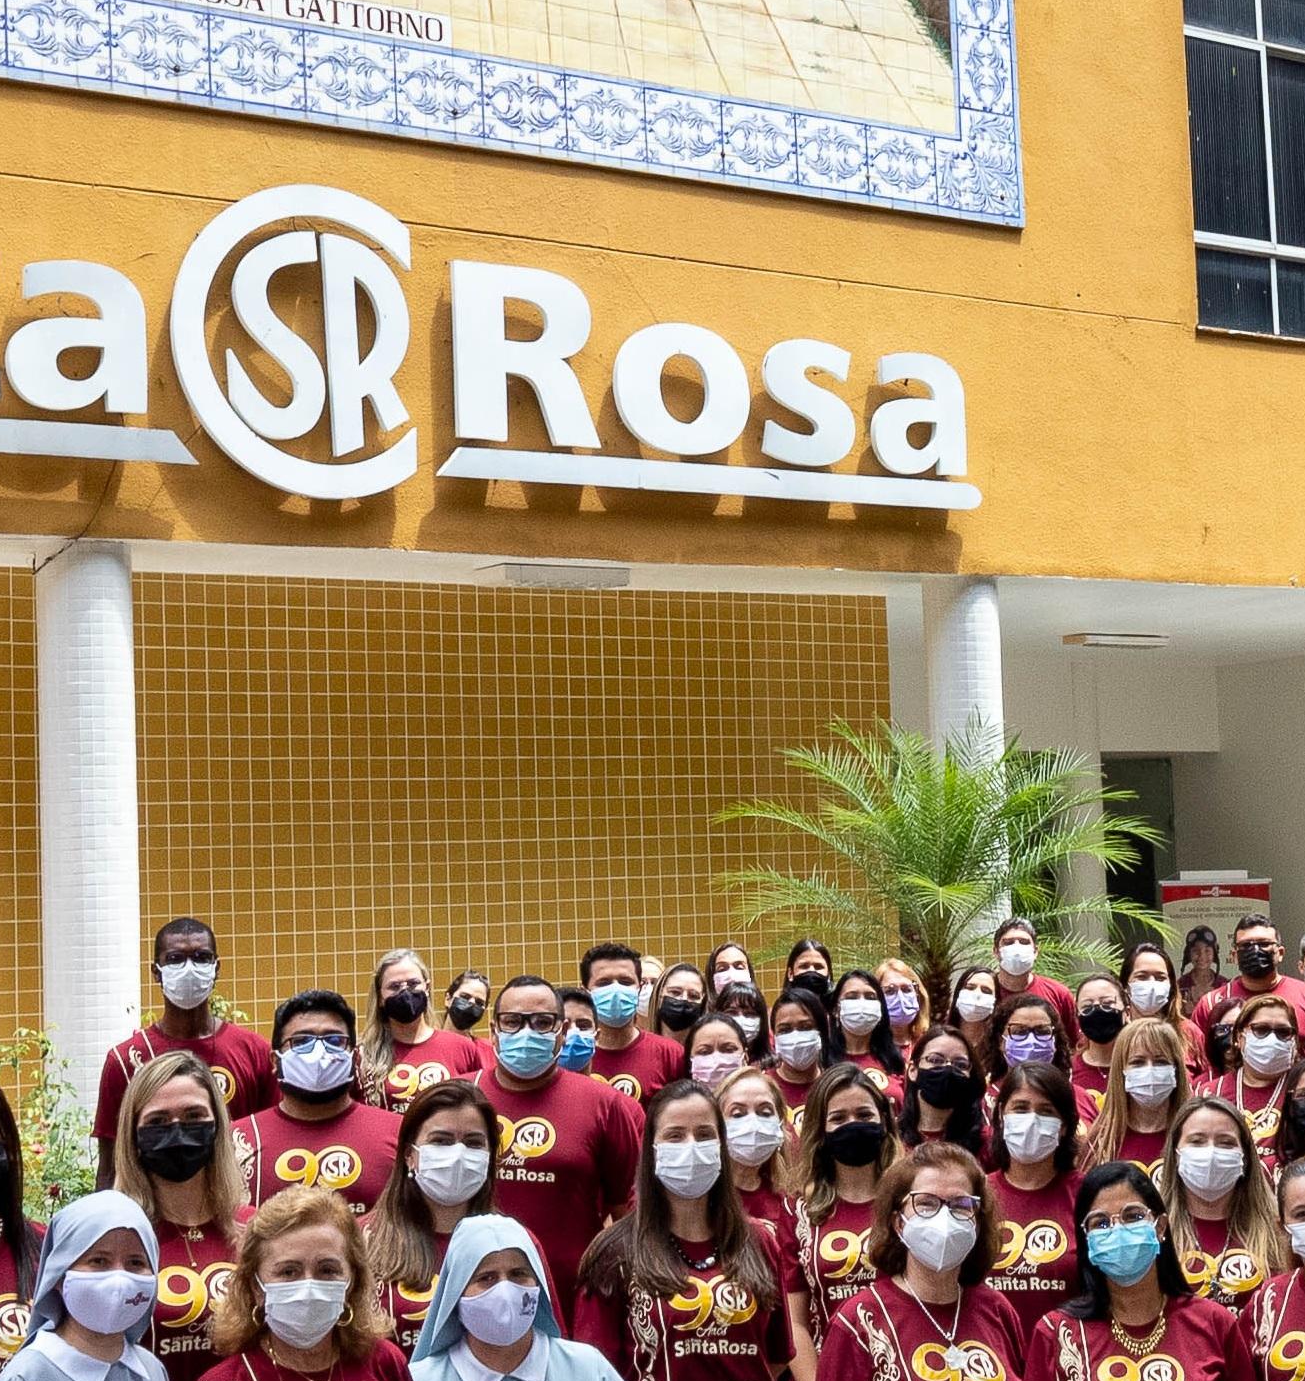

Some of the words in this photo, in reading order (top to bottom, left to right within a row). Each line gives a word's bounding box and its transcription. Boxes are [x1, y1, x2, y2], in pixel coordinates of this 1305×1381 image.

[447, 259, 971, 479] Rosa
[516, 1168, 556, 1183] Rosa
[828, 1284, 866, 1300] Sant
[985, 1276, 1028, 1291] Santa
[1029, 1277, 1066, 1291] Rosa
[160, 1335, 211, 1355] Santa
[674, 1339, 717, 1357] Santa
[718, 1339, 758, 1356] Rosa
